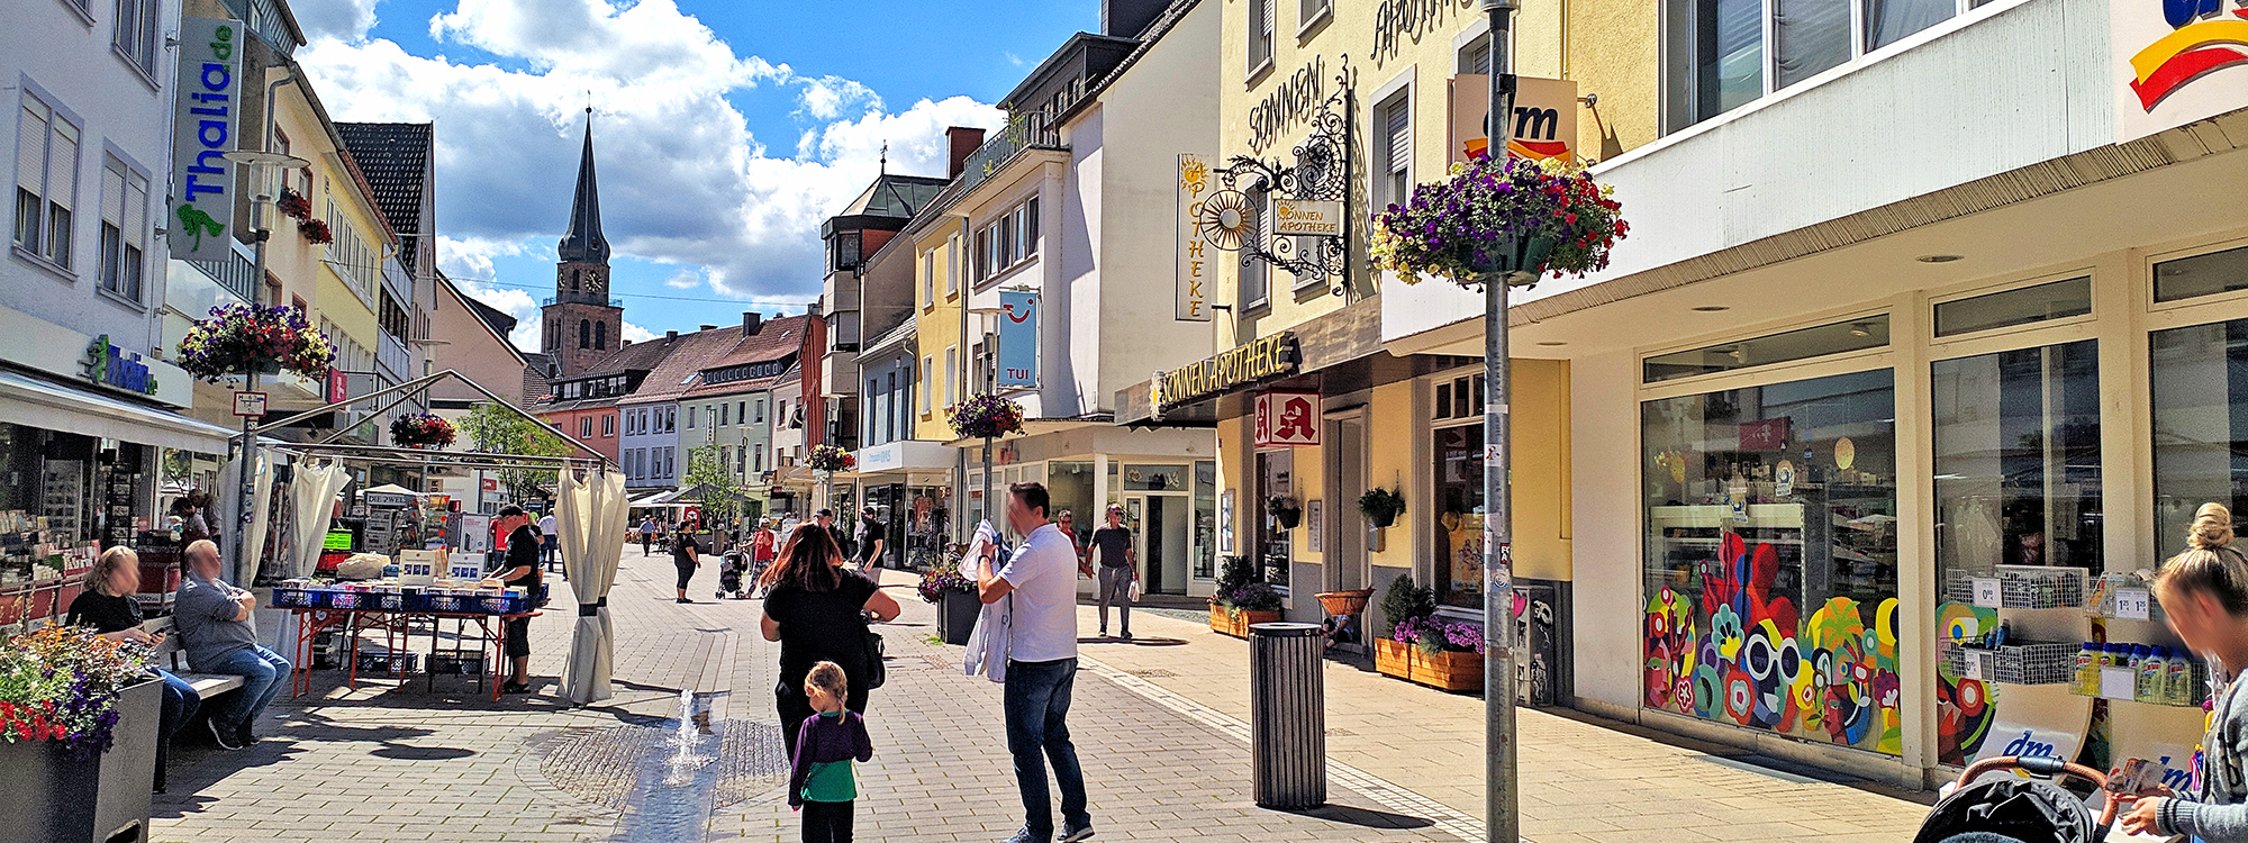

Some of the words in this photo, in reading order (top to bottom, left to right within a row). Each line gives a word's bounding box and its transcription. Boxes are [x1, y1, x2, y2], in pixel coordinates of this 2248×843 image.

[186, 25, 234, 202] Thalia.de
[1248, 54, 1321, 148] SONNEN
[1187, 162, 1206, 318] APOTHEKE
[1279, 222, 1336, 232] APOTHEKE
[1006, 368, 1029, 380] TUI
[1162, 361, 1207, 404] SONNEN
[1208, 332, 1286, 391] APOTHEKE
[1274, 396, 1316, 441] A
[2002, 730, 2055, 757] dm
[2159, 756, 2193, 791] m
